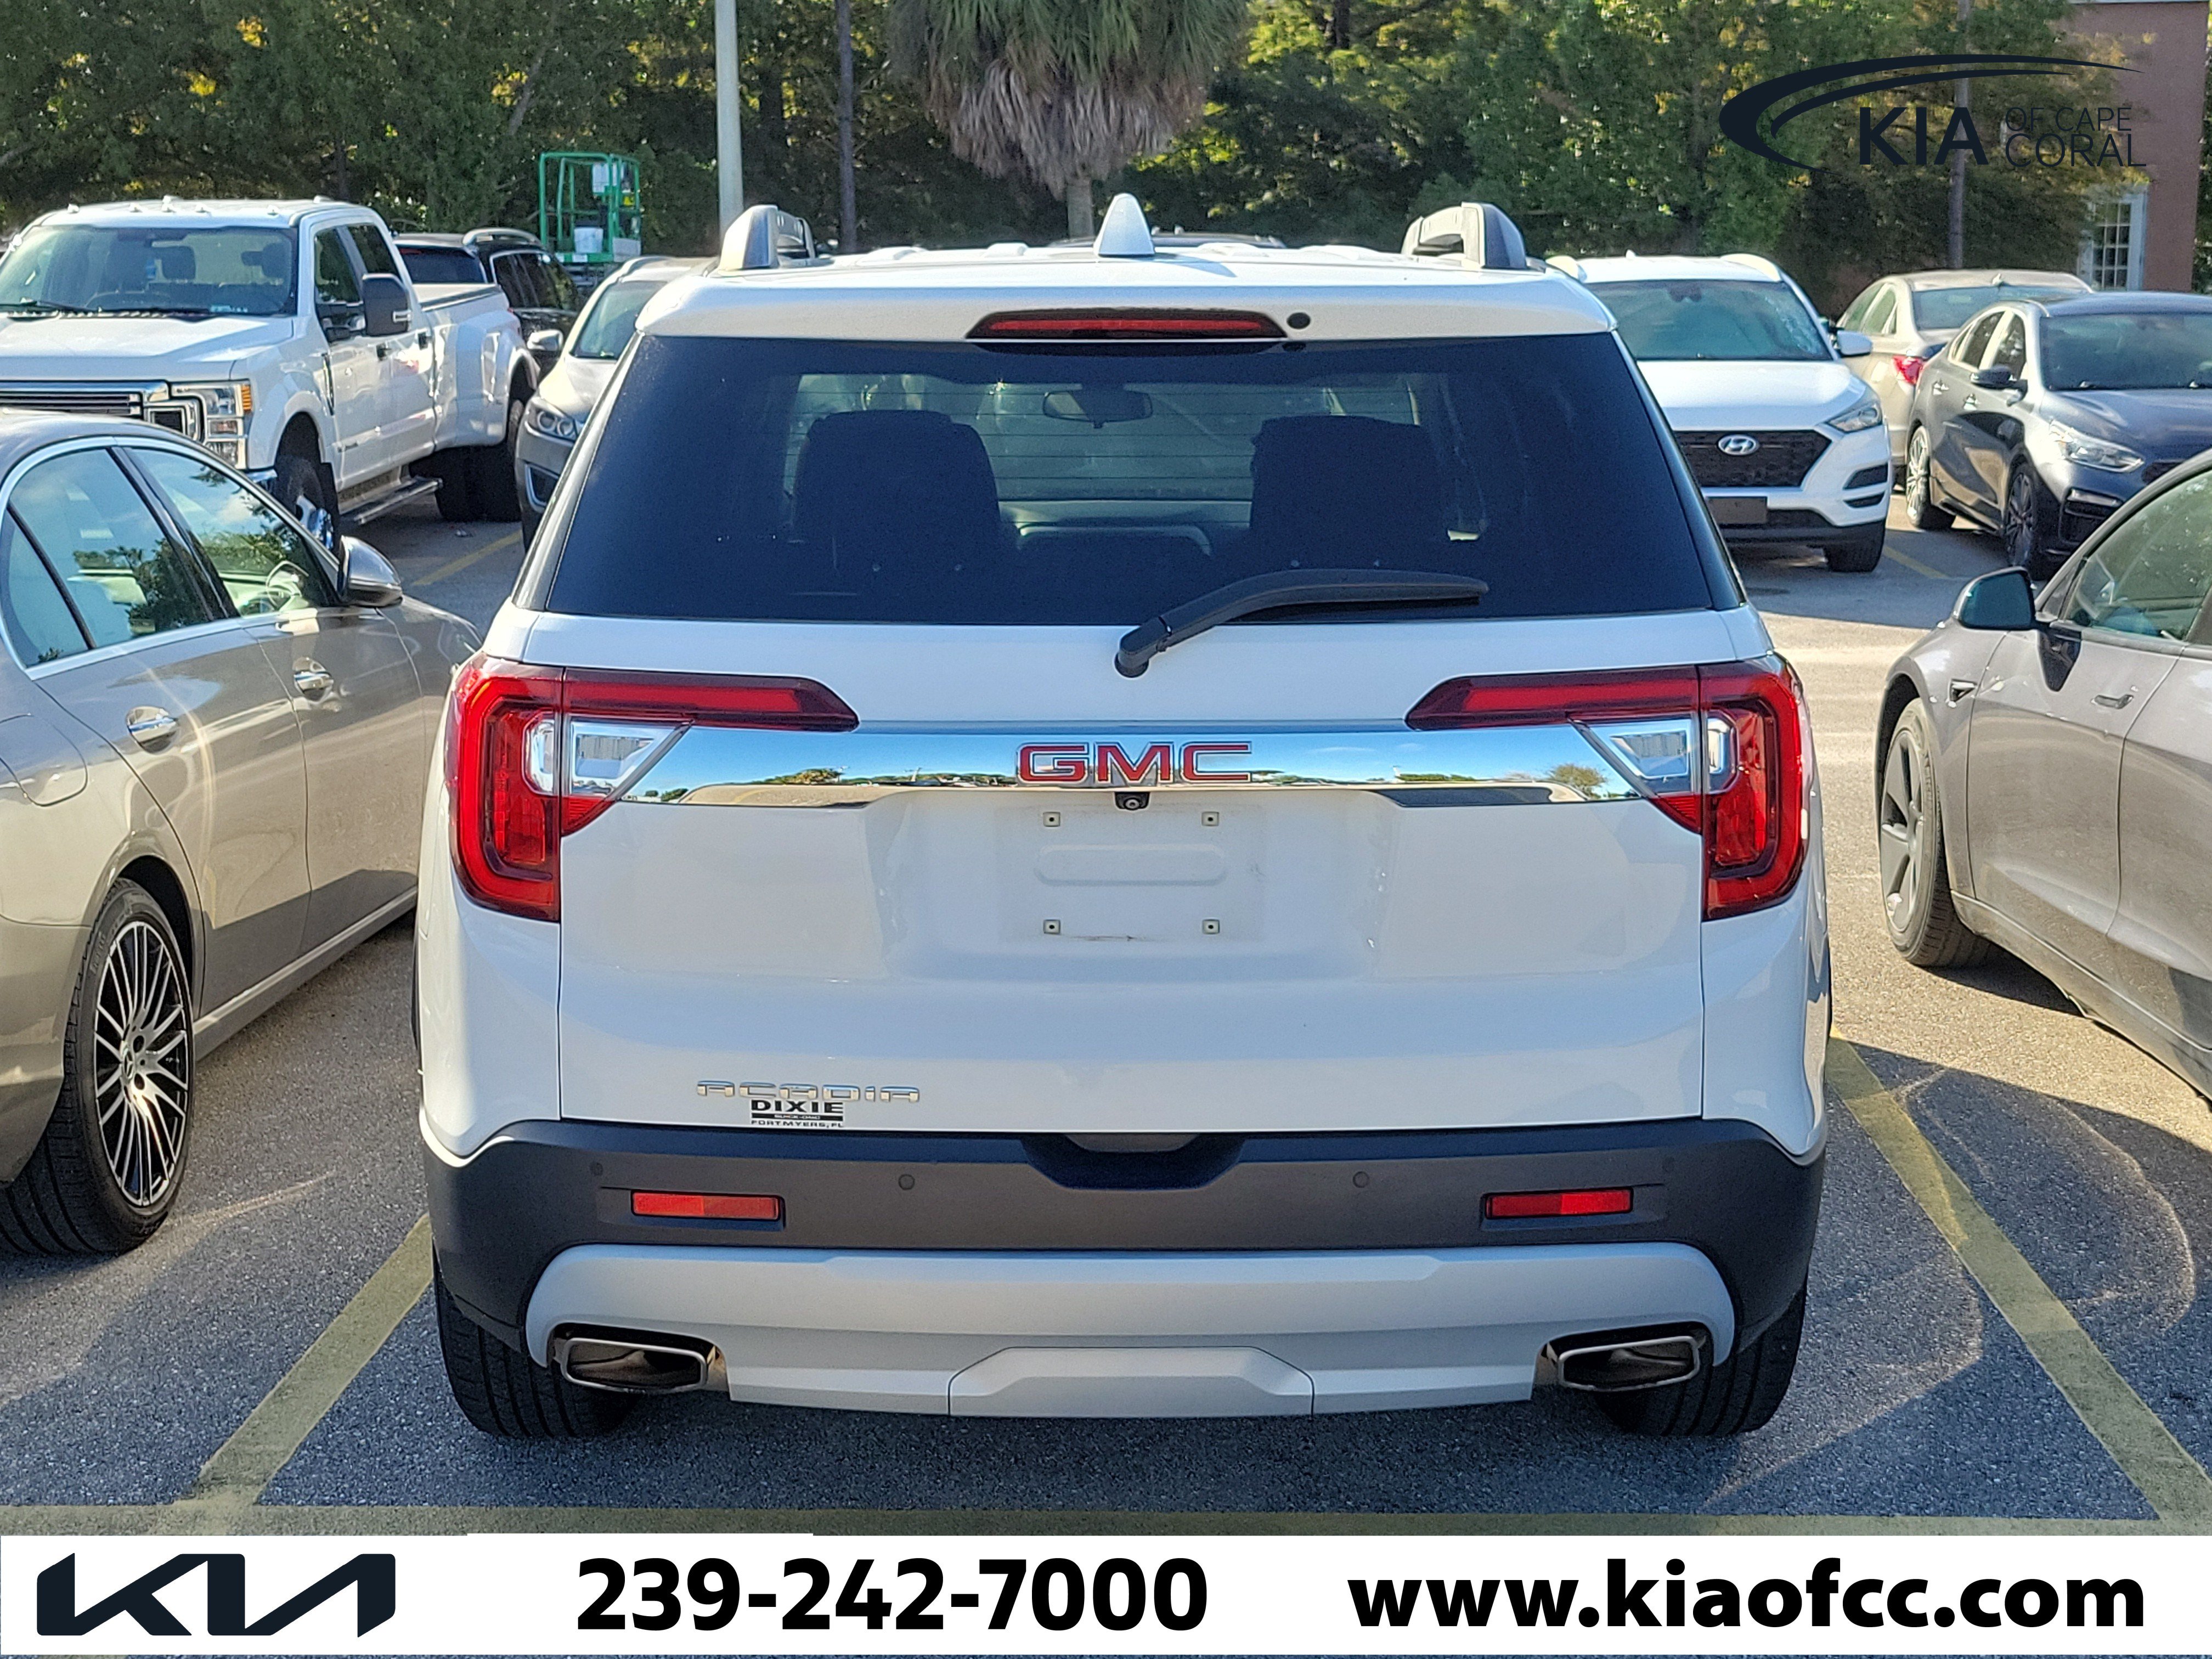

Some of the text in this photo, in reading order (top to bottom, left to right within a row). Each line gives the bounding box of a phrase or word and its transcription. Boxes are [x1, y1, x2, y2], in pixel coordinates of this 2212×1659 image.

[1017, 741, 1252, 783] GMC
[697, 1080, 920, 1103] ACADIA
[751, 1099, 843, 1113] DIXIE
